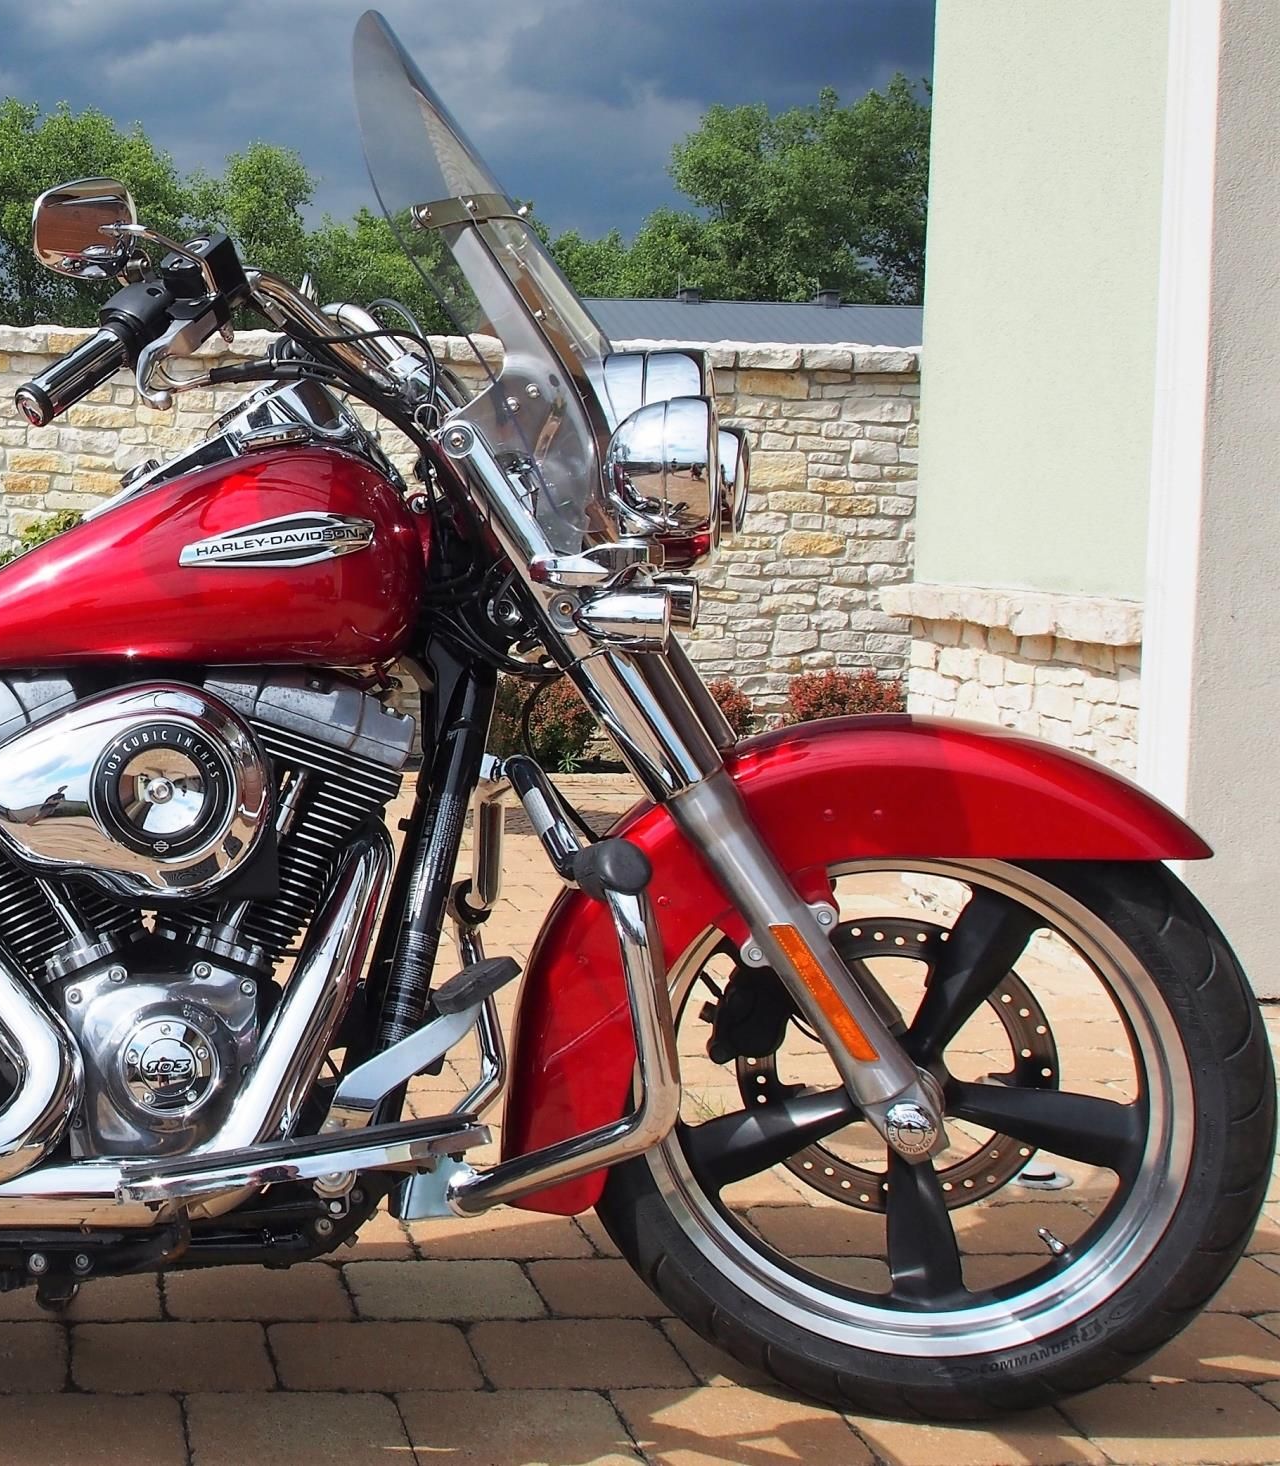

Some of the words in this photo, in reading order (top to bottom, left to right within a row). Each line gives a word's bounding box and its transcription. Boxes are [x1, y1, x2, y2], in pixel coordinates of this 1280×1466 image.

[196, 528, 359, 556] HARLEY-DAVIDSON
[104, 754, 122, 776] 103
[122, 730, 168, 752] CUBIC
[176, 733, 220, 778] INCHES
[146, 1059, 191, 1073] 103
[980, 1335, 1080, 1373] COMMANDER
